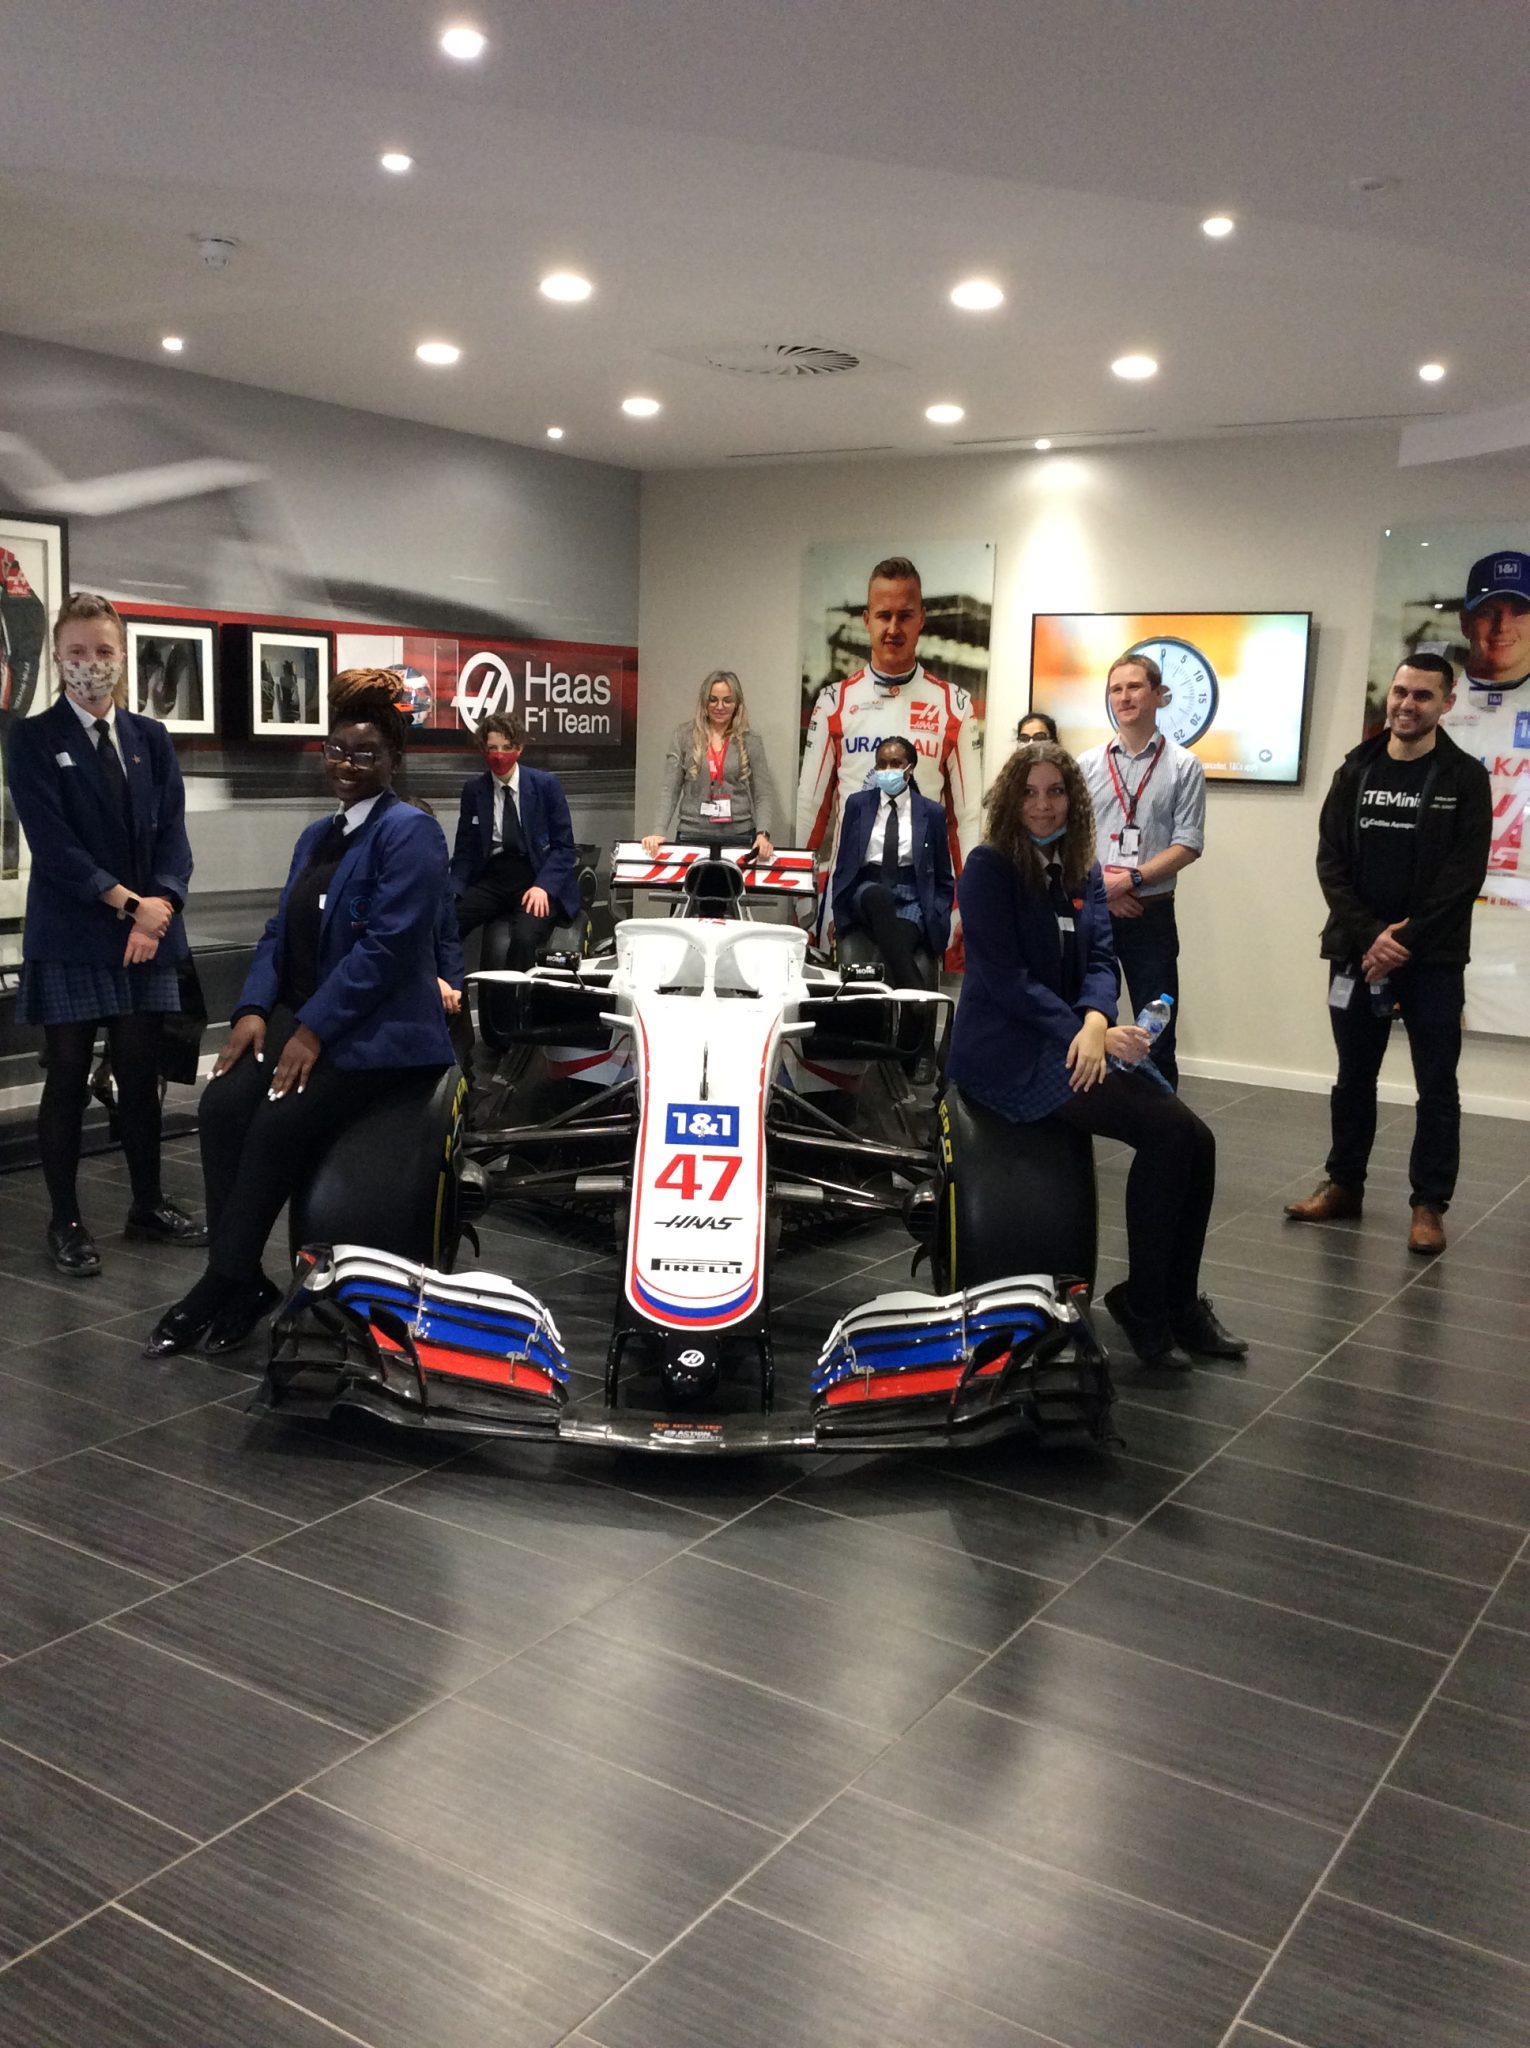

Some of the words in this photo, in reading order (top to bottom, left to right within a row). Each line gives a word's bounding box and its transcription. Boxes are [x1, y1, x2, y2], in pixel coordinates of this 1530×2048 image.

[1497, 563, 1518, 574] 1&1
[1161, 648, 1167, 658] 0
[1180, 655, 1188, 664] 5
[1193, 670, 1204, 682] 10
[525, 661, 611, 705] Haas
[1198, 692, 1207, 704] 15
[525, 707, 546, 733] F1
[554, 708, 611, 734] Team
[1190, 713, 1201, 726] 20
[1174, 729, 1185, 741] 25
[672, 1112, 732, 1138] 1&1
[654, 1153, 743, 1202] 47
[654, 1215, 743, 1230] HAAS
[651, 1258, 743, 1274] PIRELLI
